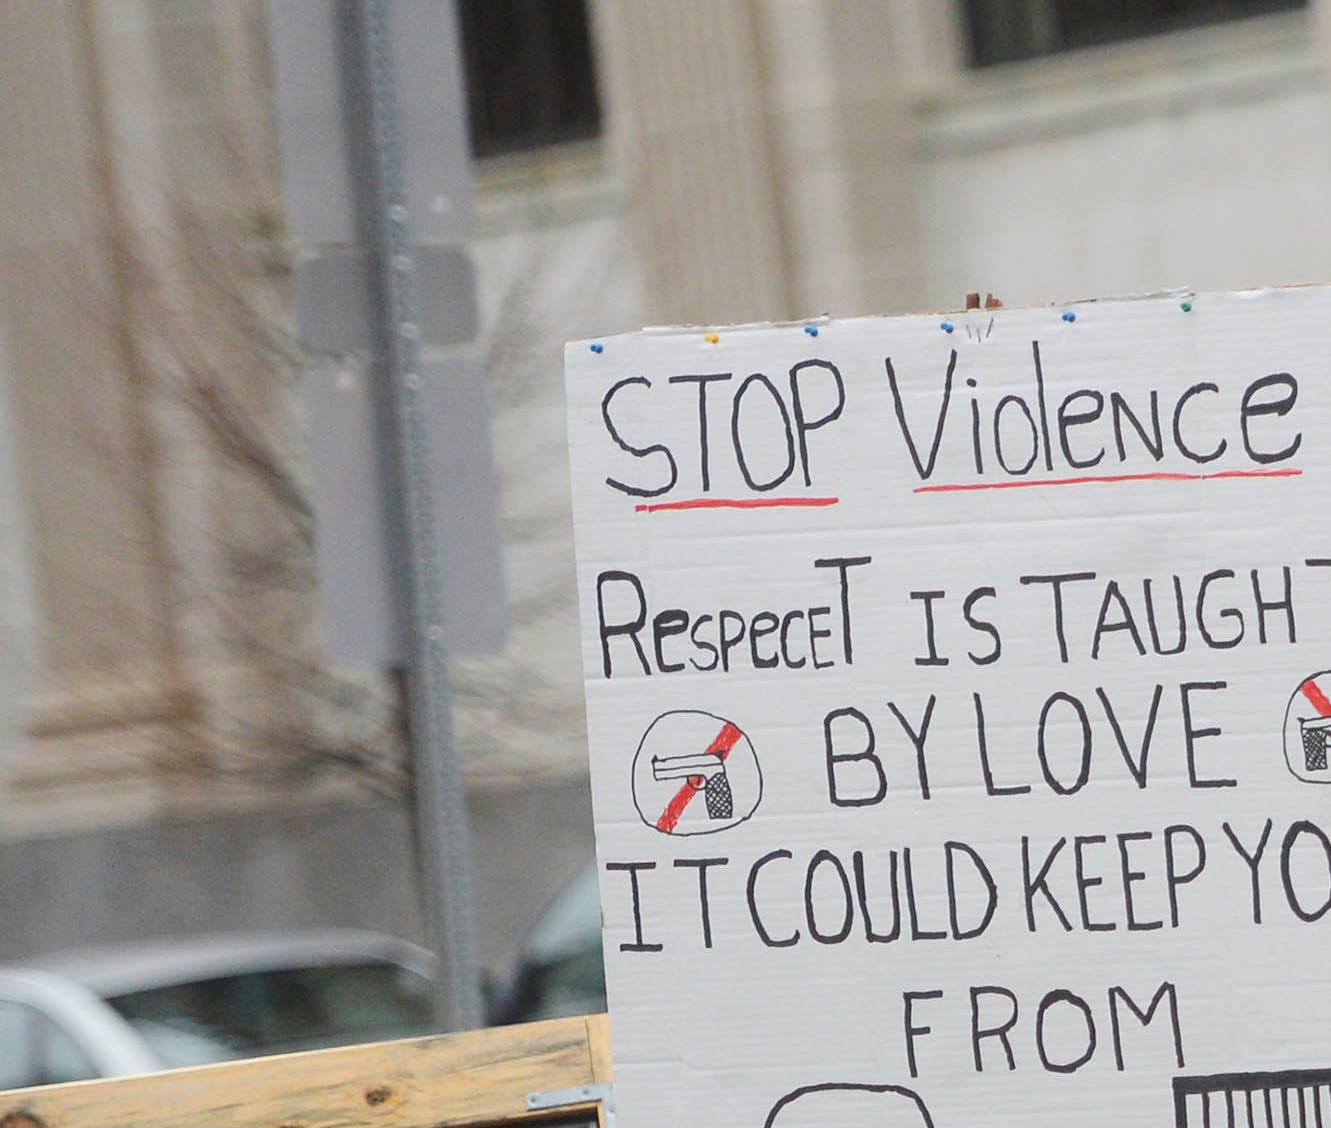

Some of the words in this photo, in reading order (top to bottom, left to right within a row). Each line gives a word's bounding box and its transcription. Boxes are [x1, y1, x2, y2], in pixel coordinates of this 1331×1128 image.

[602, 357, 845, 498] STOP
[911, 585, 1001, 666] IS
[823, 693, 937, 807] BY
[973, 681, 1238, 796] LOVE
[605, 856, 729, 953] IT
[747, 840, 998, 948] COULD
[1021, 824, 1206, 933] KEEP
[902, 981, 1186, 1078] FROM
